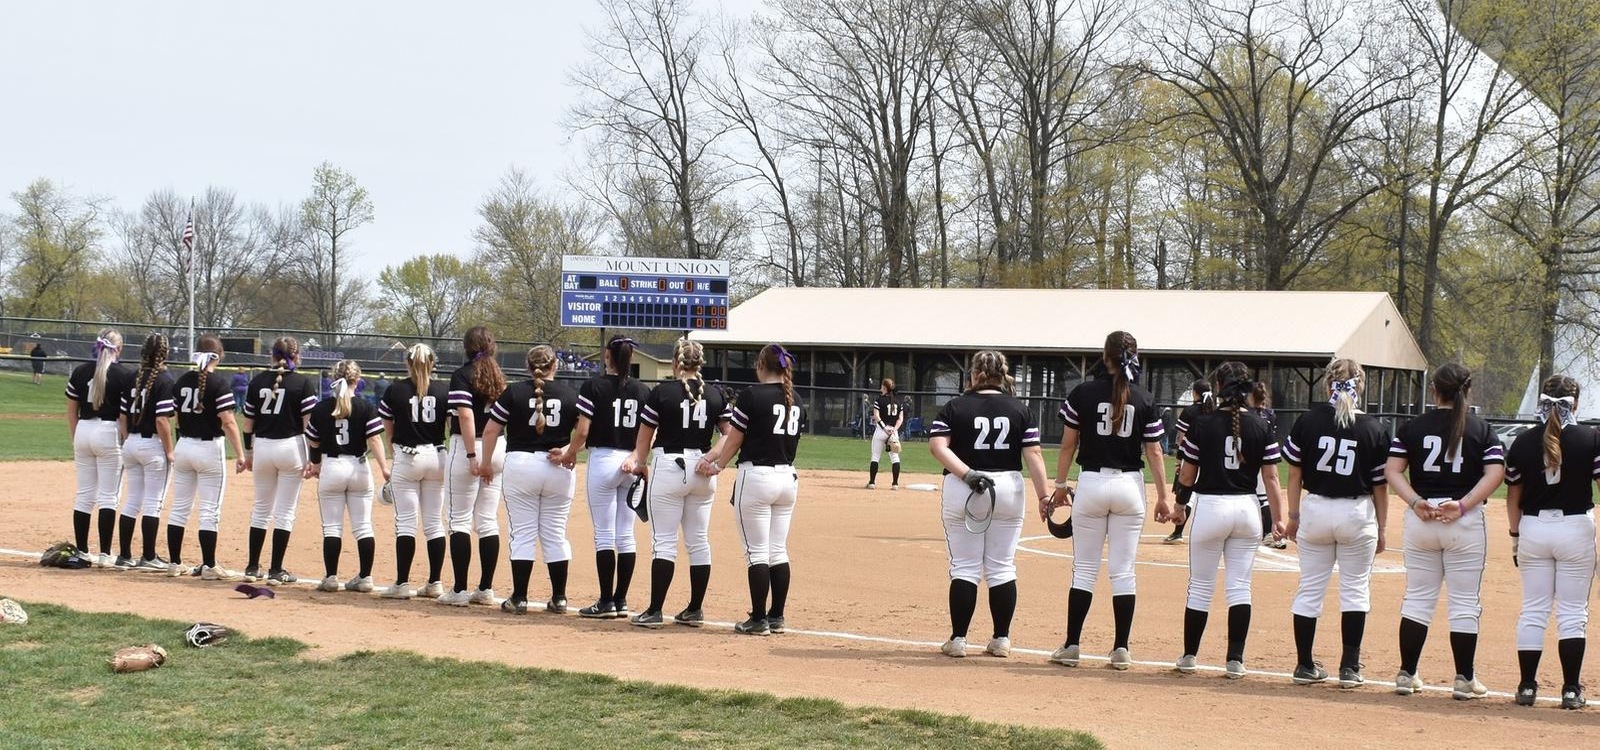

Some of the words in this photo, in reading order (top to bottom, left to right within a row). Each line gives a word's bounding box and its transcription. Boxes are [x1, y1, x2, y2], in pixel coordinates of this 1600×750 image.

[606, 260, 660, 272] MOUNT
[665, 262, 721, 275] UNION
[564, 282, 579, 290] BAT
[599, 279, 619, 288] BALL
[631, 281, 657, 289] STRIKE
[669, 281, 685, 290] OUT
[697, 282, 710, 291] H/E
[567, 302, 601, 312] VISITOR
[572, 314, 596, 324] HOME
[259, 388, 286, 415] 27
[409, 395, 437, 423] 18
[528, 398, 562, 427] 23
[612, 398, 638, 428] 13
[680, 399, 707, 429] 14
[335, 418, 350, 446] 3
[773, 404, 801, 436] 28
[973, 416, 1010, 450] 22
[1096, 402, 1136, 438] 30
[1224, 435, 1242, 470] 9
[1316, 435, 1358, 476] 25
[1423, 435, 1464, 473] 24
